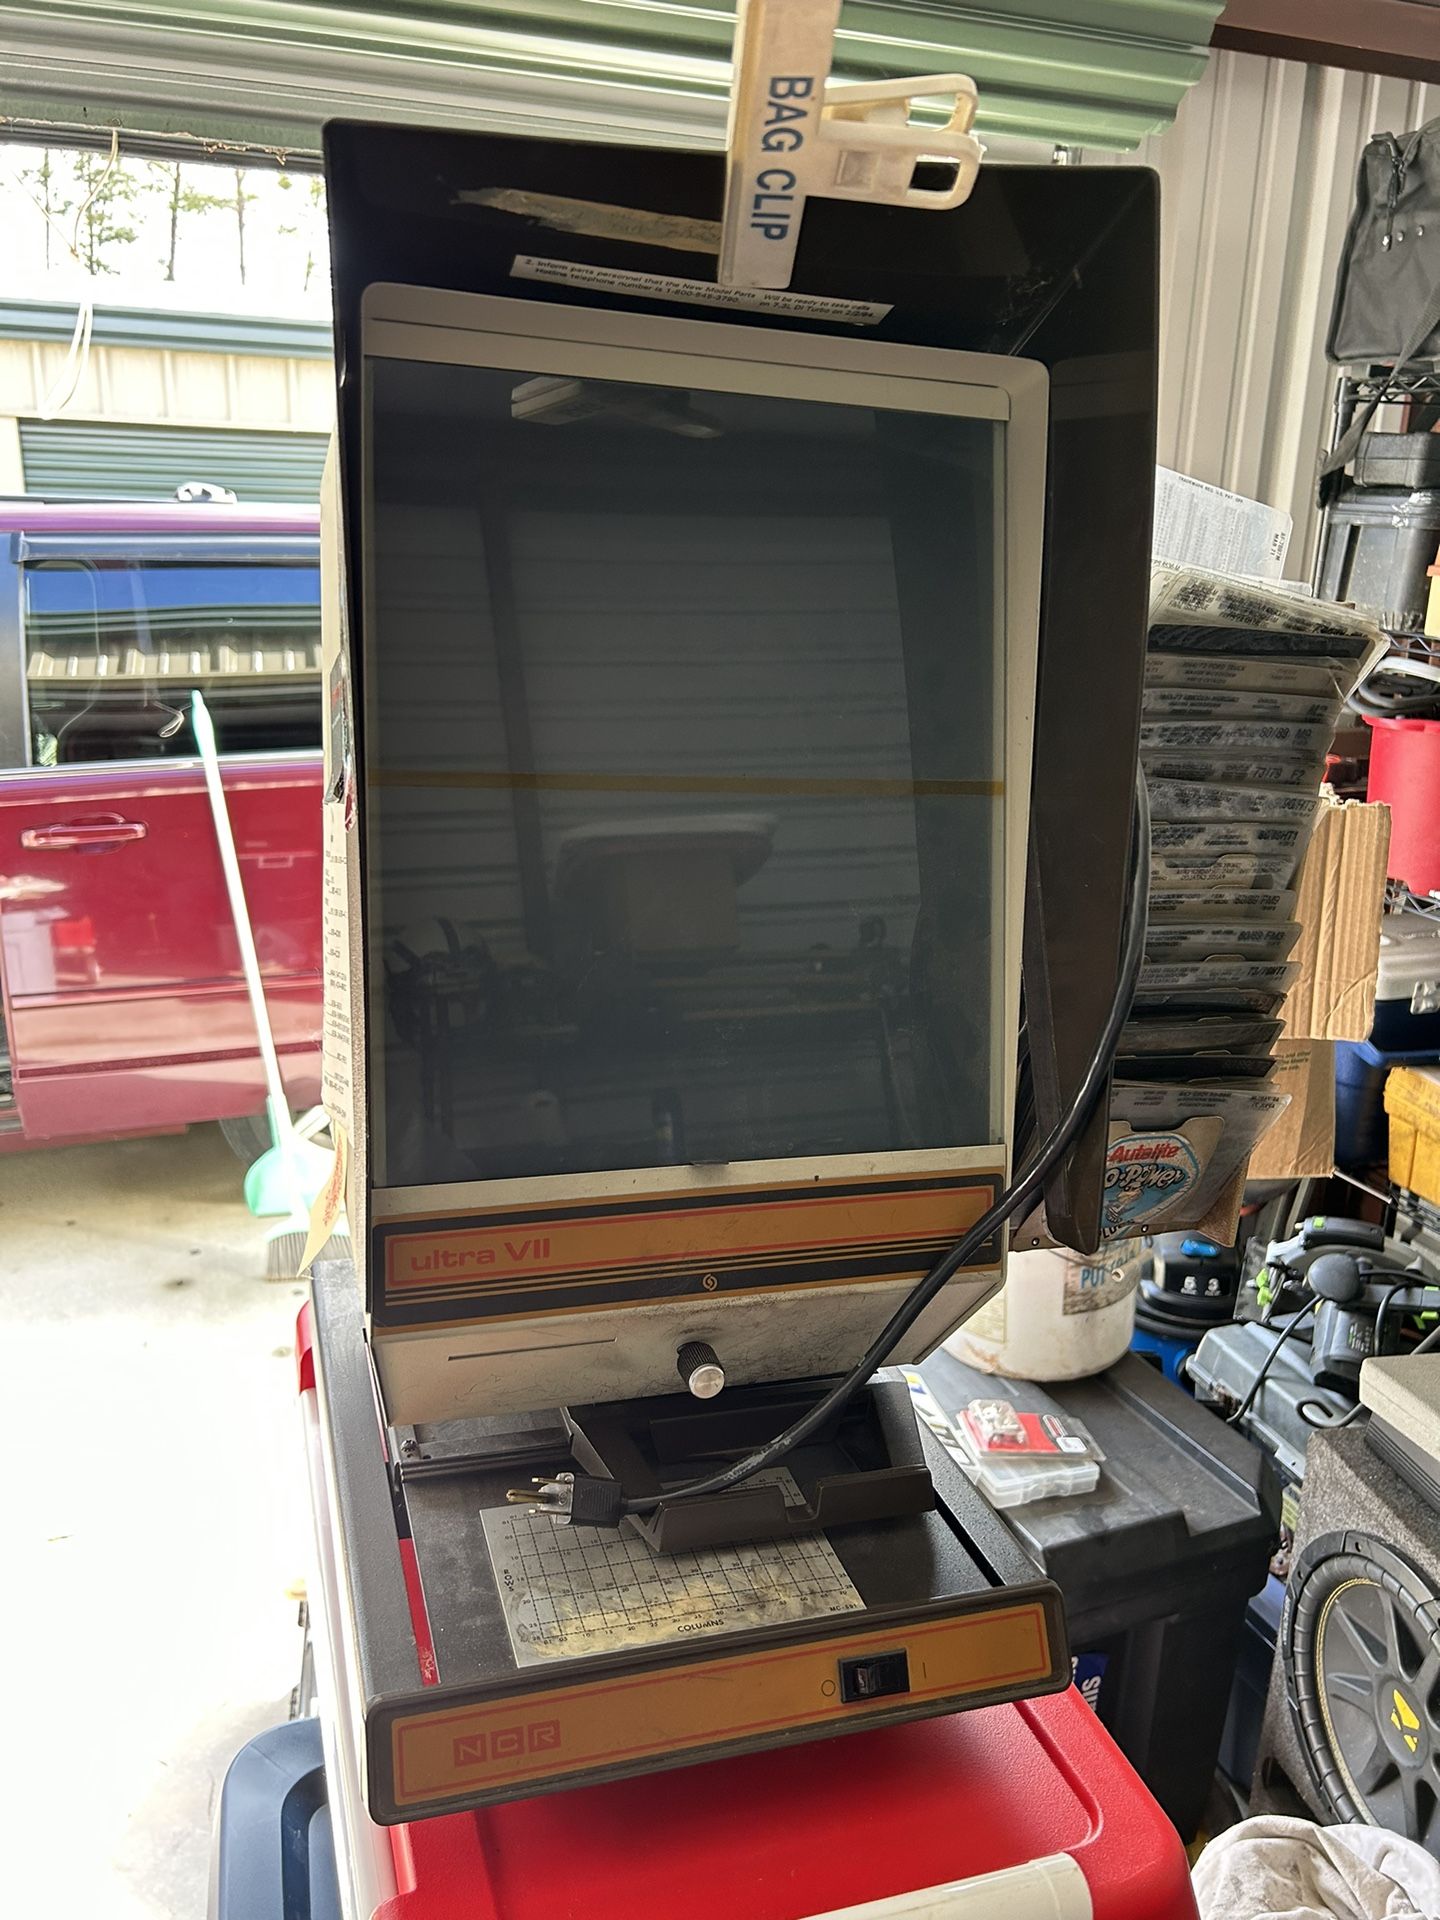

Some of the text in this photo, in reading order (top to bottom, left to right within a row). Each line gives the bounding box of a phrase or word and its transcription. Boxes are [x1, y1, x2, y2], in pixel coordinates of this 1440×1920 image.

[750, 76, 815, 241] BAG CLIP
[536, 268, 568, 278] Hotline
[570, 274, 616, 287] telephone
[618, 281, 652, 291] number
[537, 261, 568, 271] Inform
[570, 266, 594, 276] parts
[597, 270, 643, 283] personnel
[644, 277, 663, 286] that
[665, 281, 681, 289] the
[683, 283, 703, 291] New
[705, 286, 733, 296] Model
[734, 290, 756, 299] Parts
[794, 298, 818, 308] ready
[1106, 1142, 1180, 1162] Autolite
[410, 1238, 551, 1272] ultra VII
[503, 1568, 515, 1592] ROWS
[677, 1618, 725, 1633] COLUMNS
[452, 1718, 561, 1768] NCR
